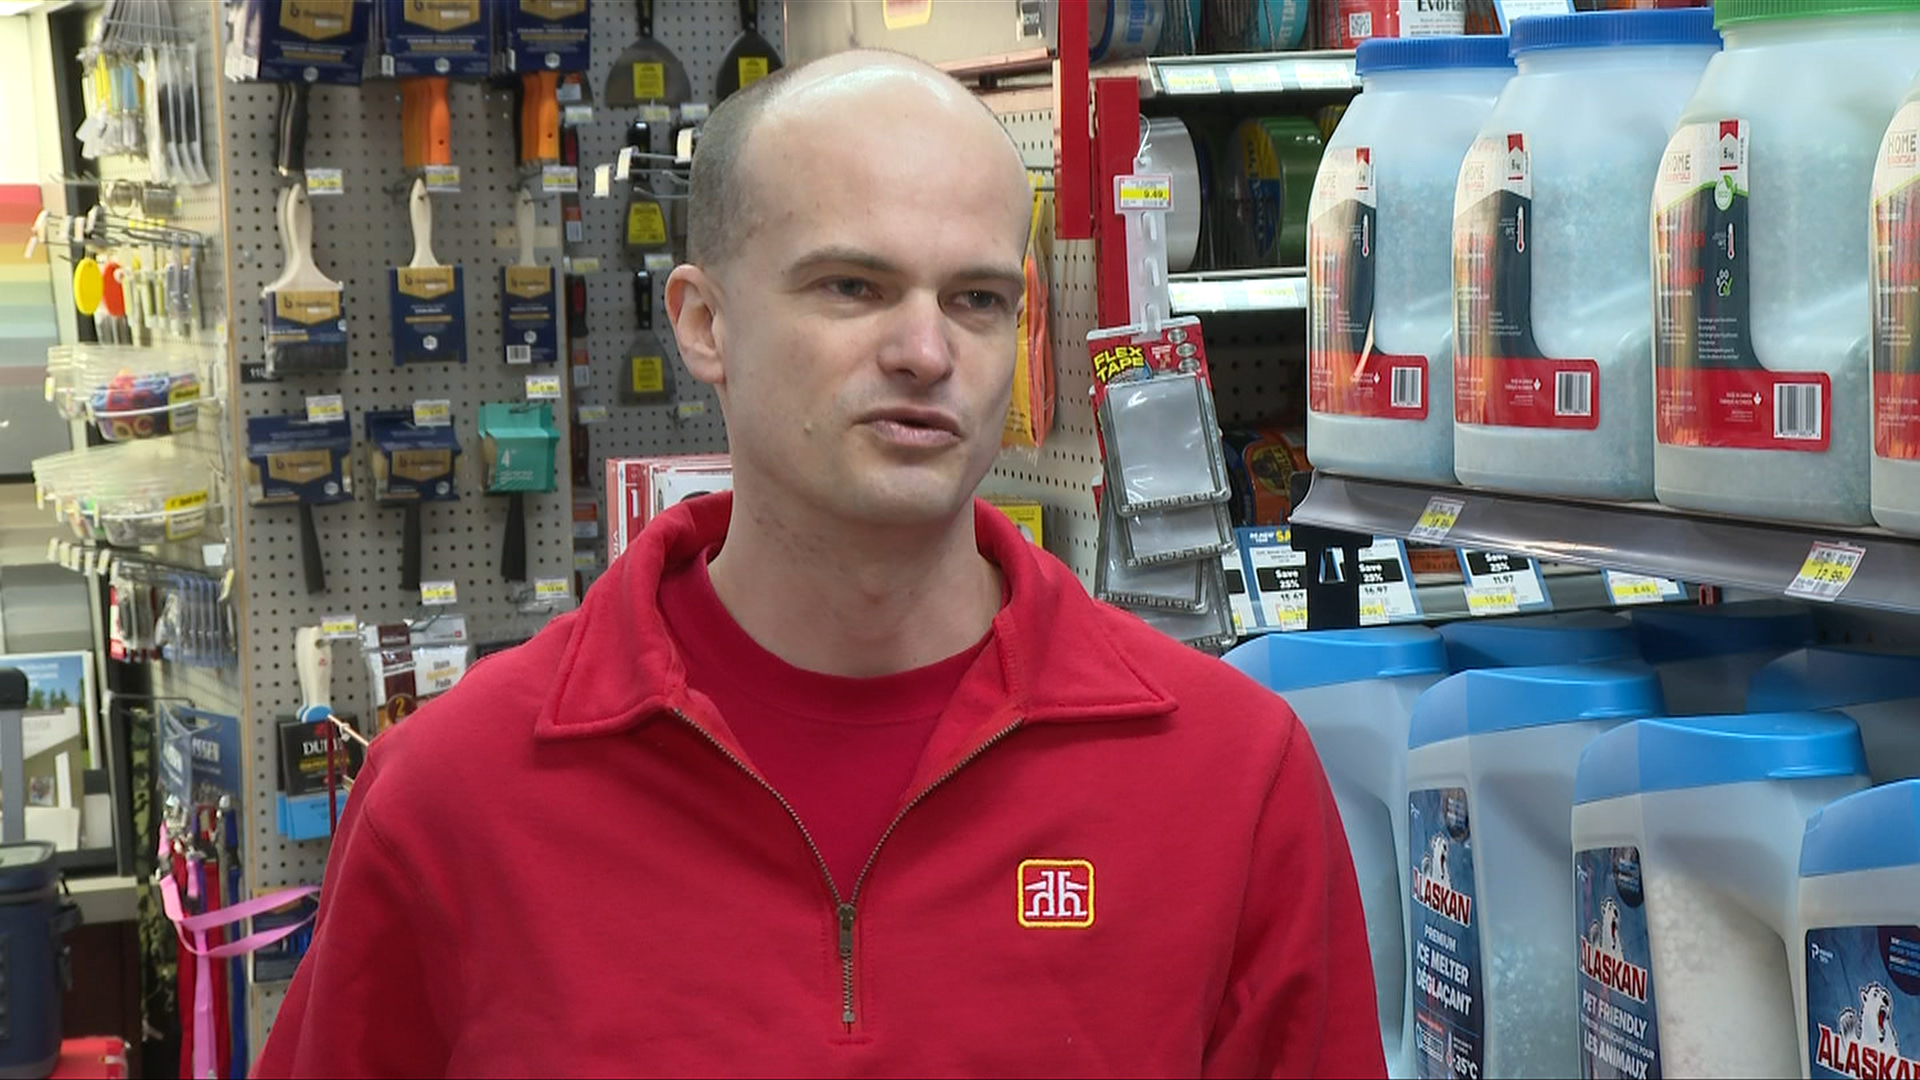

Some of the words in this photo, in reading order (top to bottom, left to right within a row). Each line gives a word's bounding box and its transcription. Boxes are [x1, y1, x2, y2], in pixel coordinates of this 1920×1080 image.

[1887, 133, 1916, 154] HOME
[1143, 189, 1164, 199] 9.49
[1093, 346, 1142, 371] FLEX
[1096, 355, 1145, 383] TAPE
[1359, 562, 1382, 573] Save
[1485, 552, 1508, 563] Save
[1490, 562, 1510, 572] 25%
[1275, 568, 1299, 579] Save
[1279, 579, 1300, 589] 25%
[1363, 572, 1383, 583] 25%
[1492, 574, 1514, 585] 11.97
[1413, 866, 1471, 927] ALASKAN
[1424, 924, 1457, 952] PREMIUM
[1416, 940, 1430, 966] ICE
[1430, 951, 1470, 988] MELTER
[1580, 938, 1648, 1002] ALASKAN
[1416, 965, 1472, 1016] DÉGLAÇANT
[1582, 989, 1597, 1015] PET
[1598, 998, 1648, 1040] FRIENDLY
[1583, 1029, 1598, 1056] LES
[1598, 1040, 1649, 1080] ANIMAUX
[1816, 1026, 1920, 1080] ALASKA
